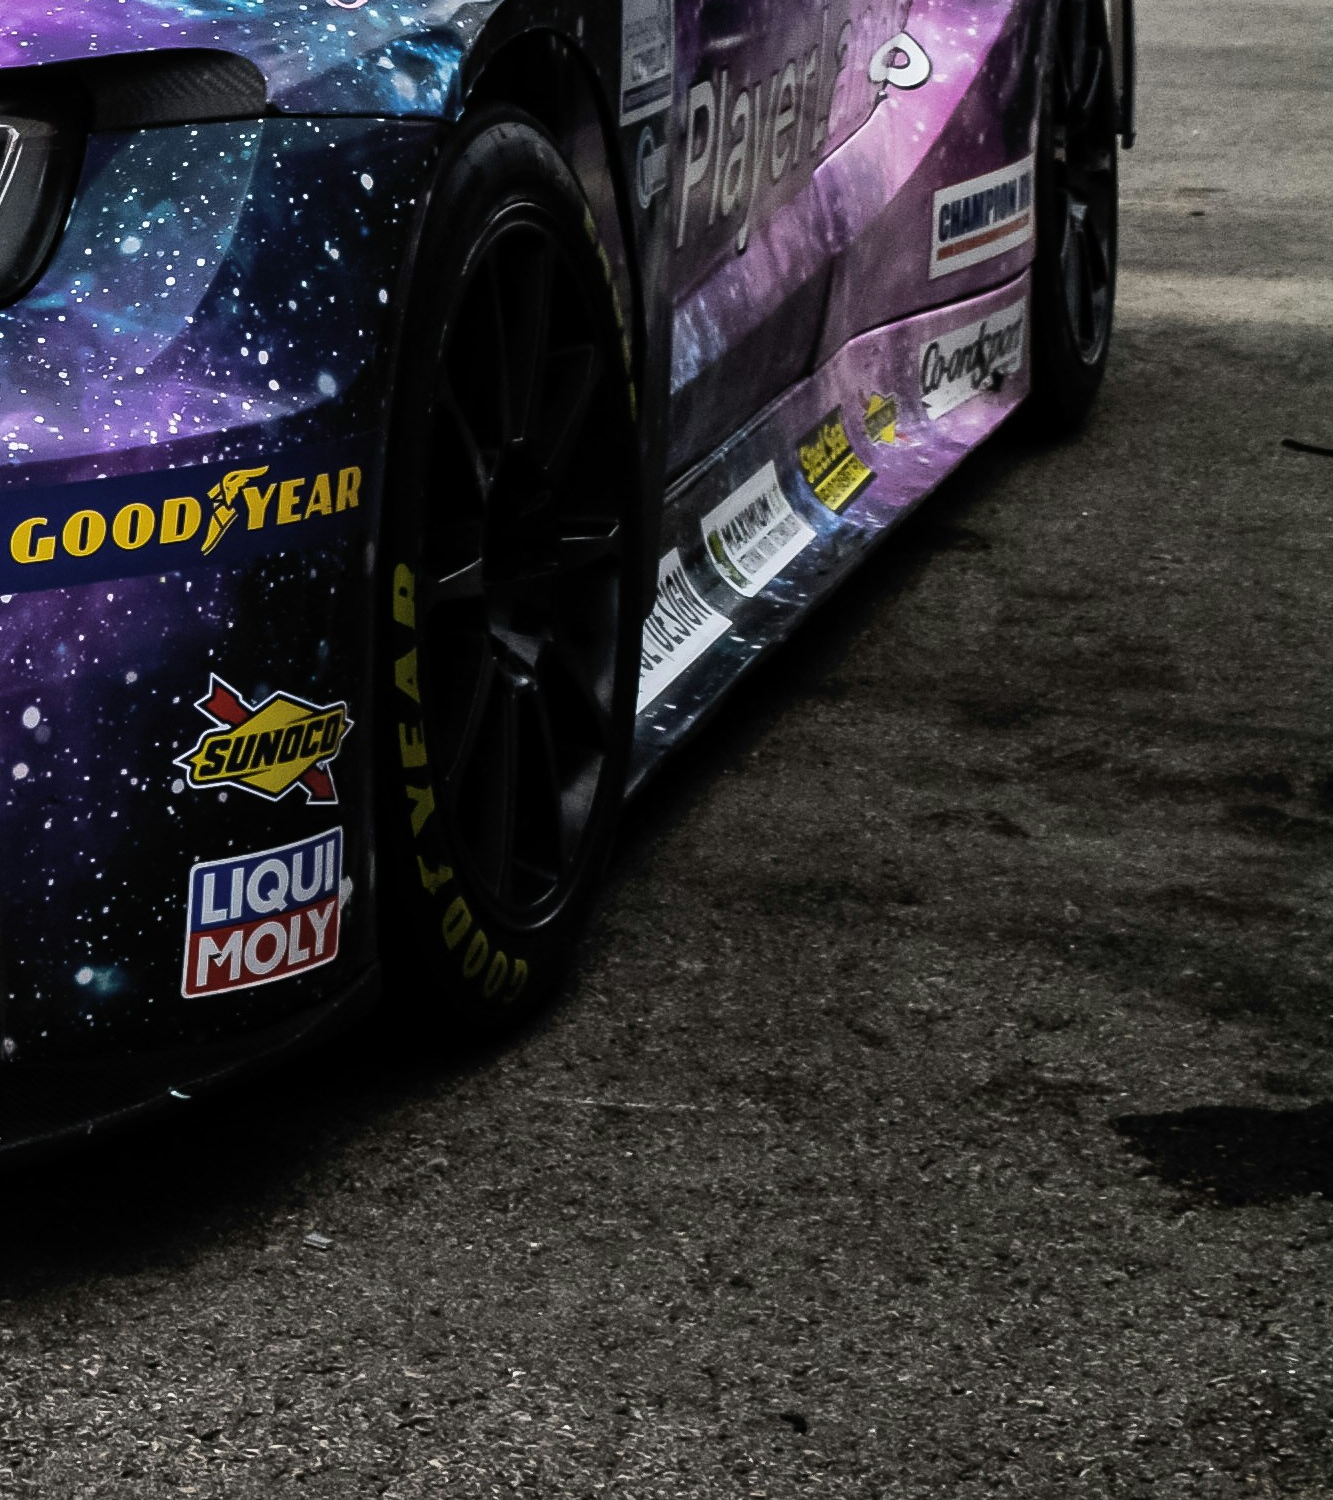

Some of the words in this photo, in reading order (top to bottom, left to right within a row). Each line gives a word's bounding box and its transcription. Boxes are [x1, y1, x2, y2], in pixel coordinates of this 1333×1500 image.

[939, 178, 1016, 242] CHAMPION
[10, 465, 362, 564] GOODYEAR
[197, 710, 343, 775] SUNOCO
[200, 838, 335, 926] LIQUI
[195, 900, 337, 987] MOLY
